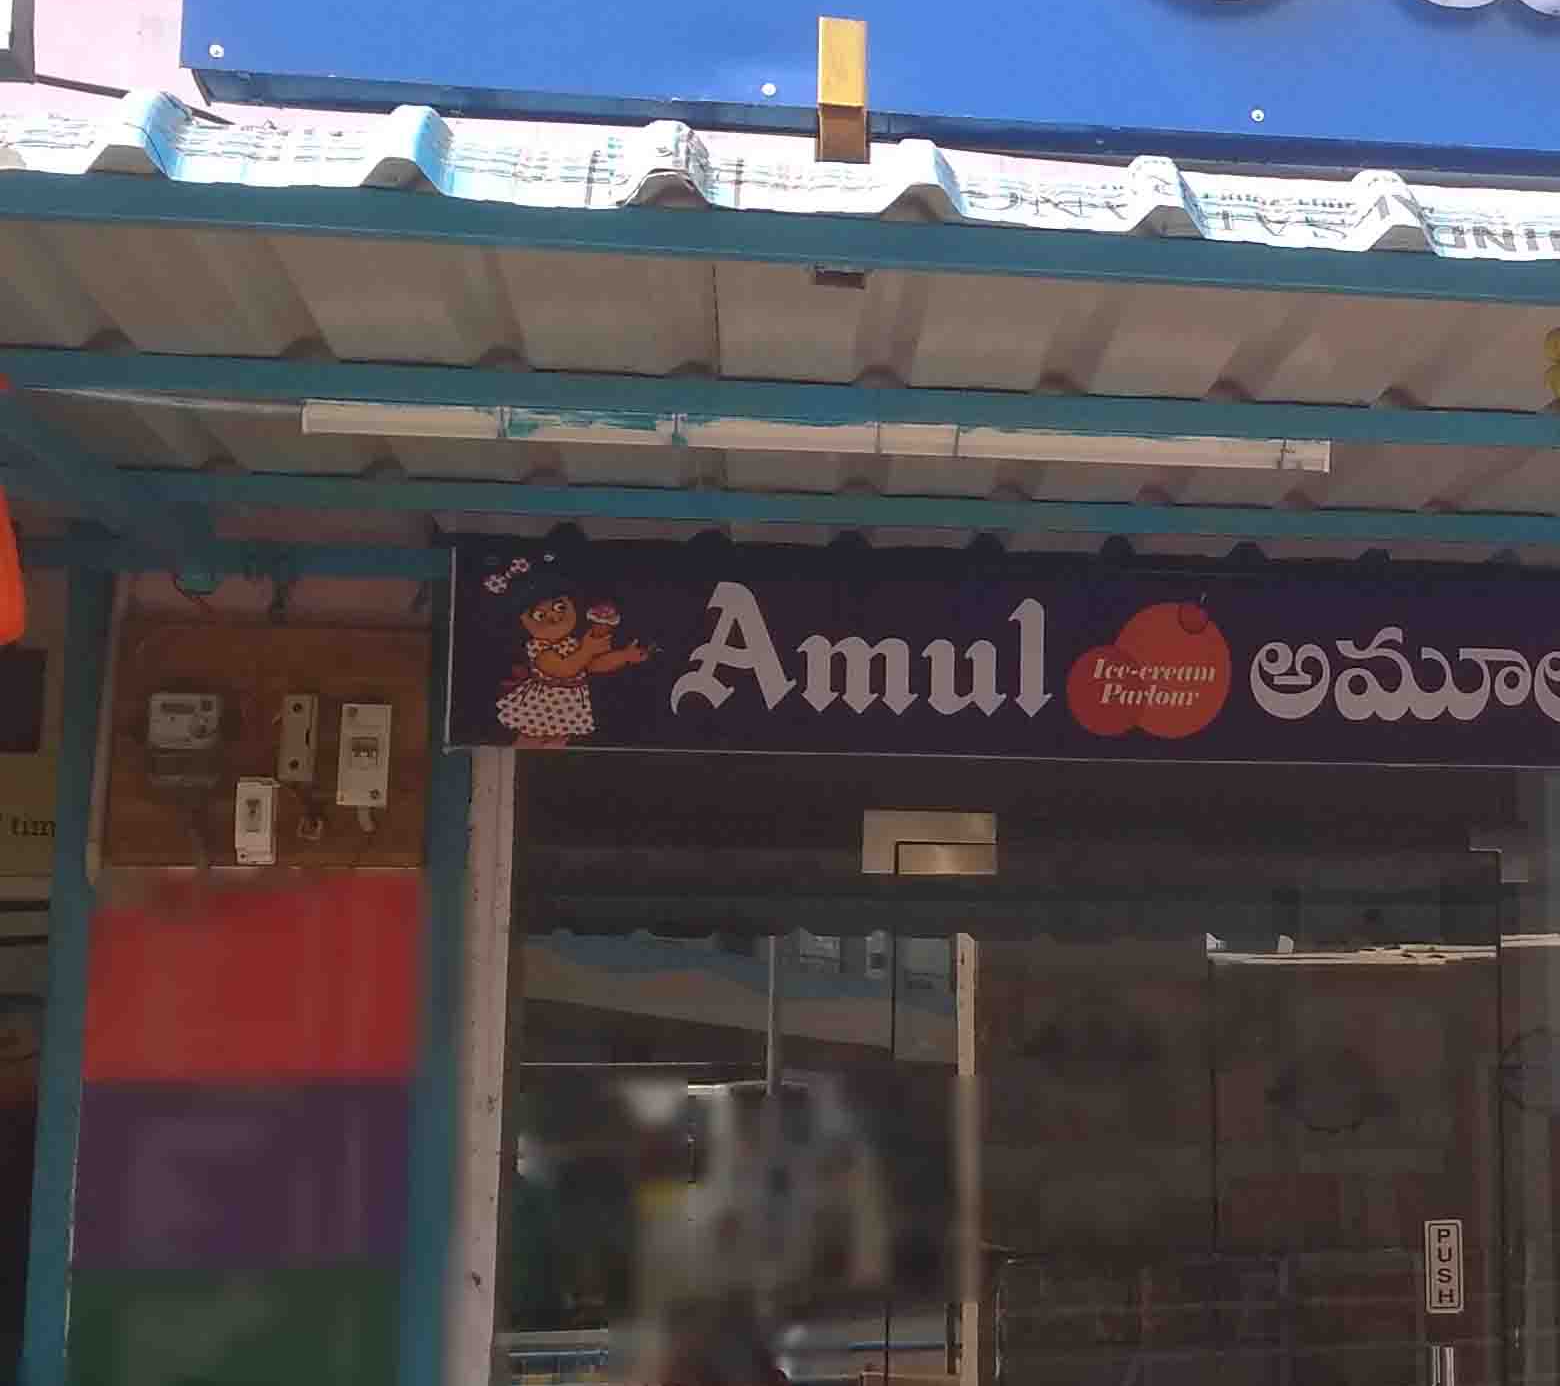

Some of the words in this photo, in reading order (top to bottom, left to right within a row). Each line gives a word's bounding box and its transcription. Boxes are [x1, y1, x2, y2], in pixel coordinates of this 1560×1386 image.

[670, 581, 1052, 717] Amul
[1093, 658, 1217, 683] Ice-cream
[1100, 683, 1200, 708] Parlour
[1437, 1228, 1455, 1304] PUSH
